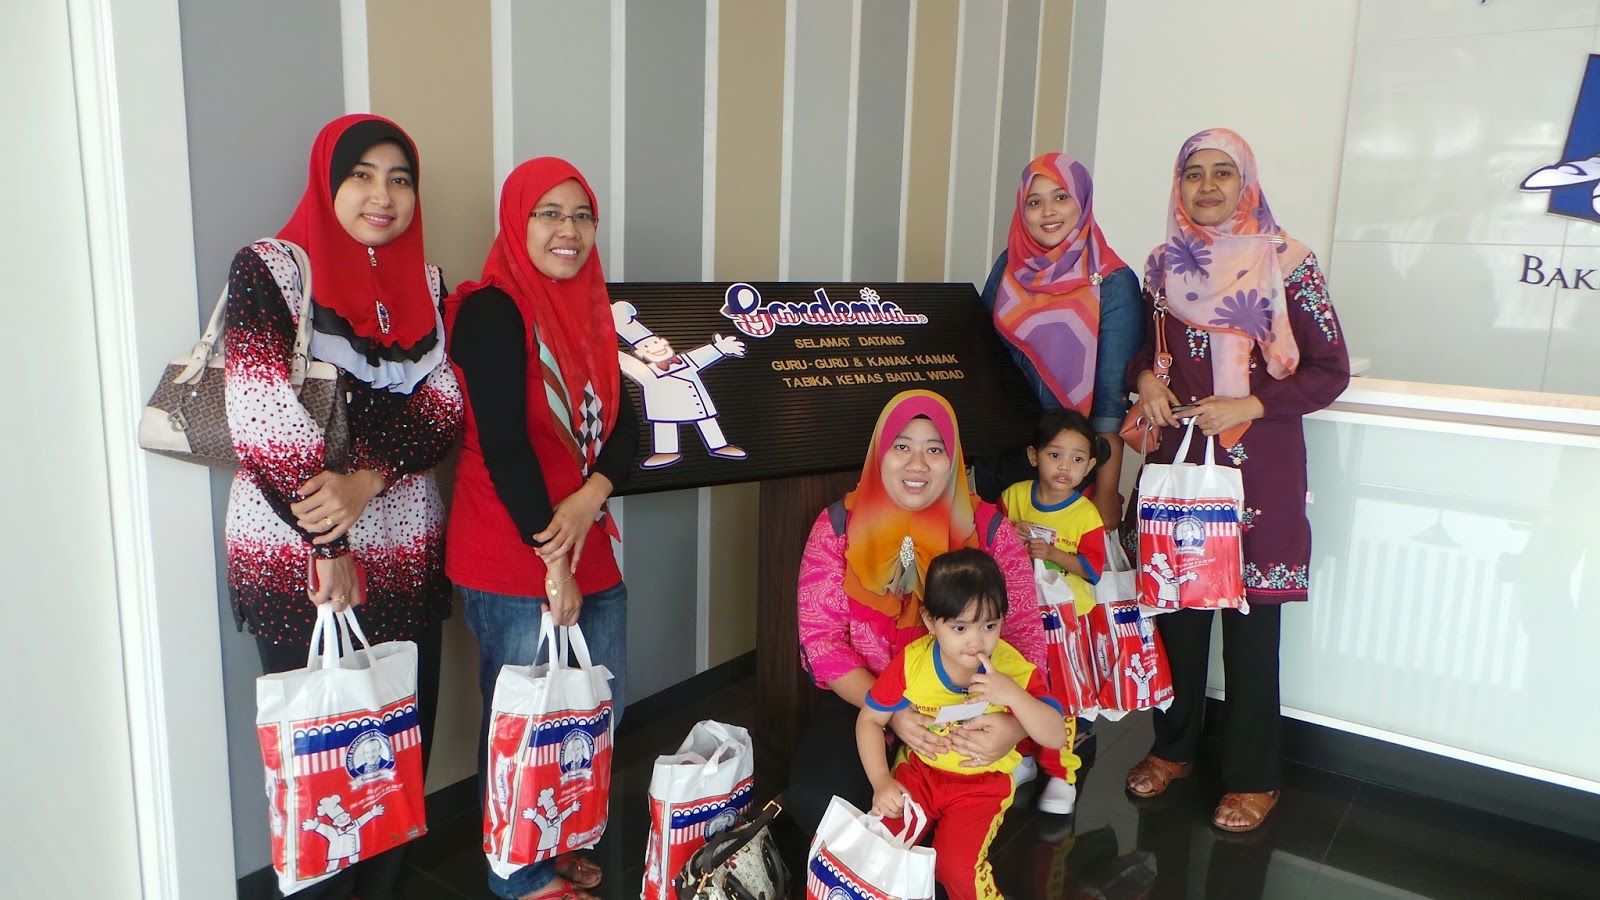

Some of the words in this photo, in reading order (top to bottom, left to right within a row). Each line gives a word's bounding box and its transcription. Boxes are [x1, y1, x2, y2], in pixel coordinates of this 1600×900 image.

[794, 337, 850, 349] SELAMAT
[857, 335, 905, 348] DATANG
[771, 357, 849, 371] GURU-GURU
[853, 358, 864, 368] &
[867, 353, 959, 367] KANAK-KANAK
[782, 375, 830, 388] TABIKA
[836, 372, 883, 385] KEMAS
[886, 371, 926, 382] BAITUL
[928, 369, 965, 380] WIDAD
